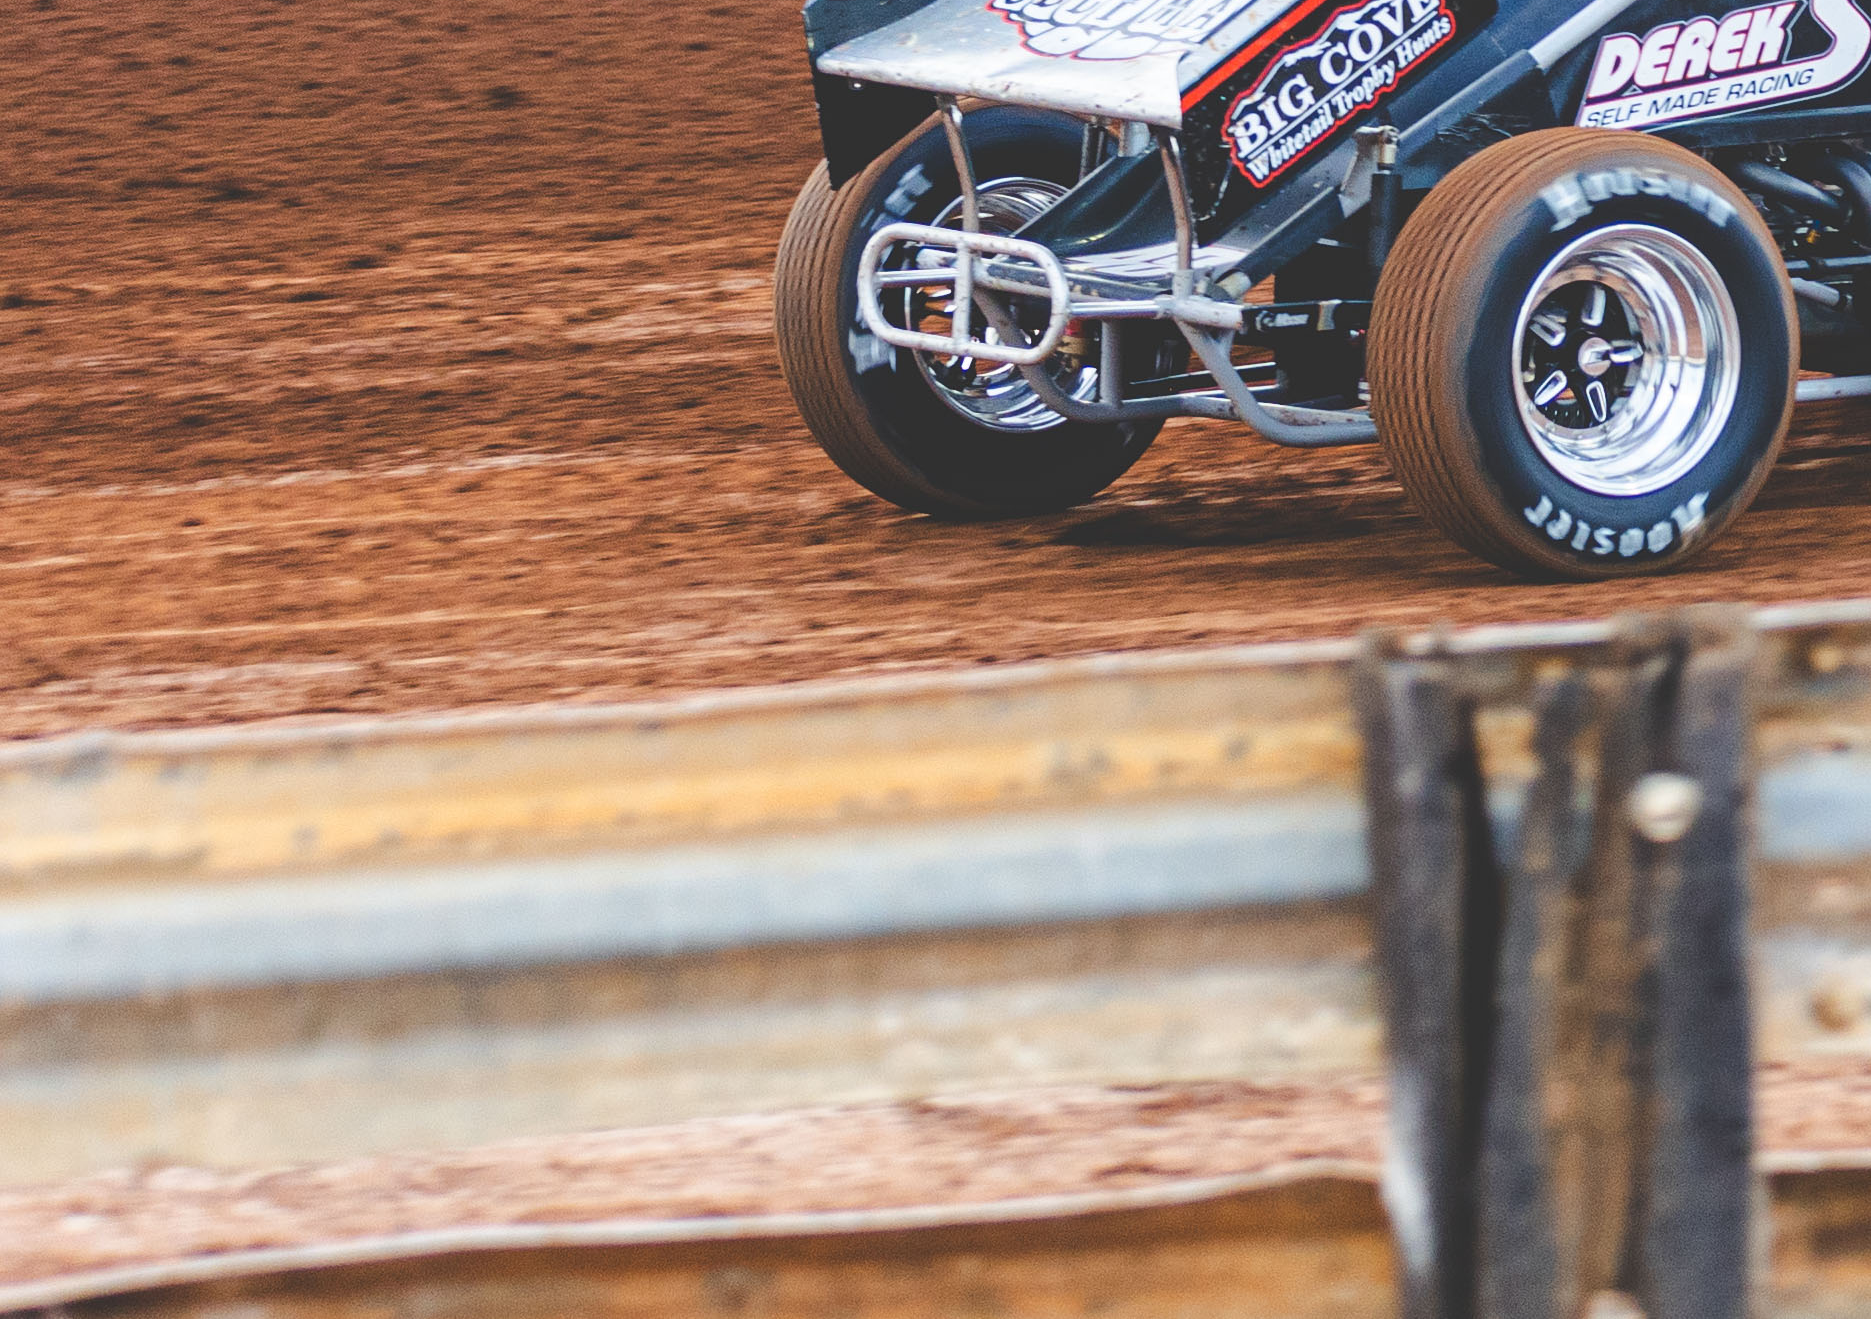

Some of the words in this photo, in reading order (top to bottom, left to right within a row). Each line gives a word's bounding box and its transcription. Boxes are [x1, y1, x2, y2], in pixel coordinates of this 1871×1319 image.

[1587, 1, 1801, 100] DEREK
[1228, 73, 1317, 159] BIG
[1246, 108, 1335, 181] Whitetail
[1331, 60, 1396, 118] Trophy
[1393, 16, 1452, 69] Hunts
[1586, 103, 1641, 129] SELF
[1647, 89, 1719, 117] MADE
[1725, 67, 1815, 100] RACING
